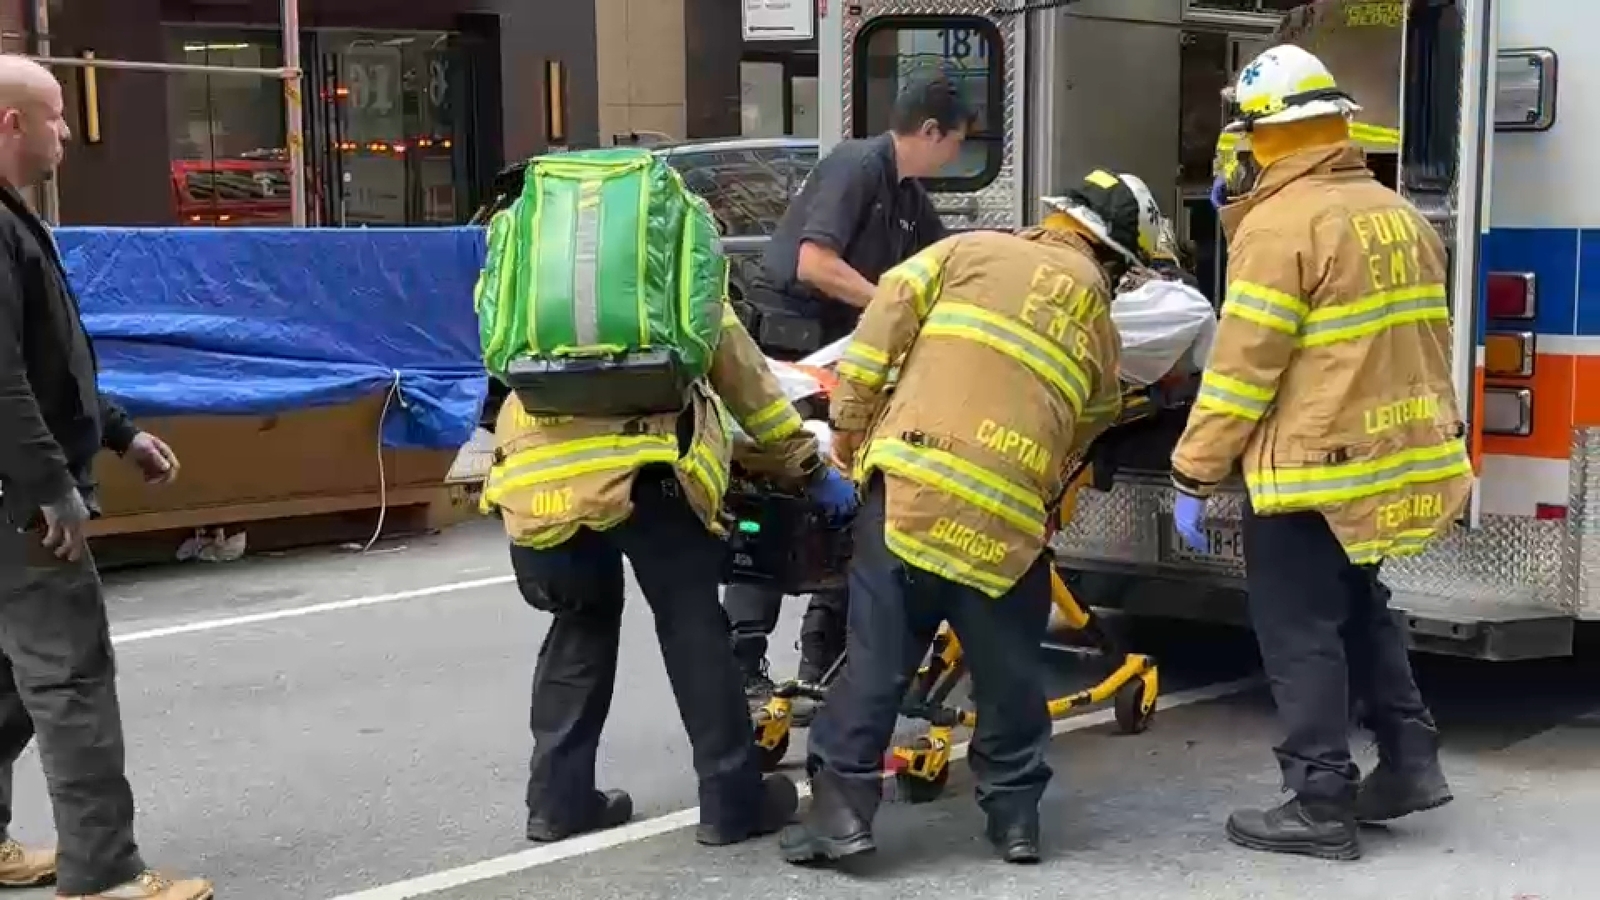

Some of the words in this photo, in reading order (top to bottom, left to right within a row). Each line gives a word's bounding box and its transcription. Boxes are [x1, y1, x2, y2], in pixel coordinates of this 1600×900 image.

[1030, 263, 1105, 321] FDNY
[1020, 292, 1088, 361] EMS
[531, 486, 573, 516] DIAZ
[930, 517, 1008, 564] BURGOS
